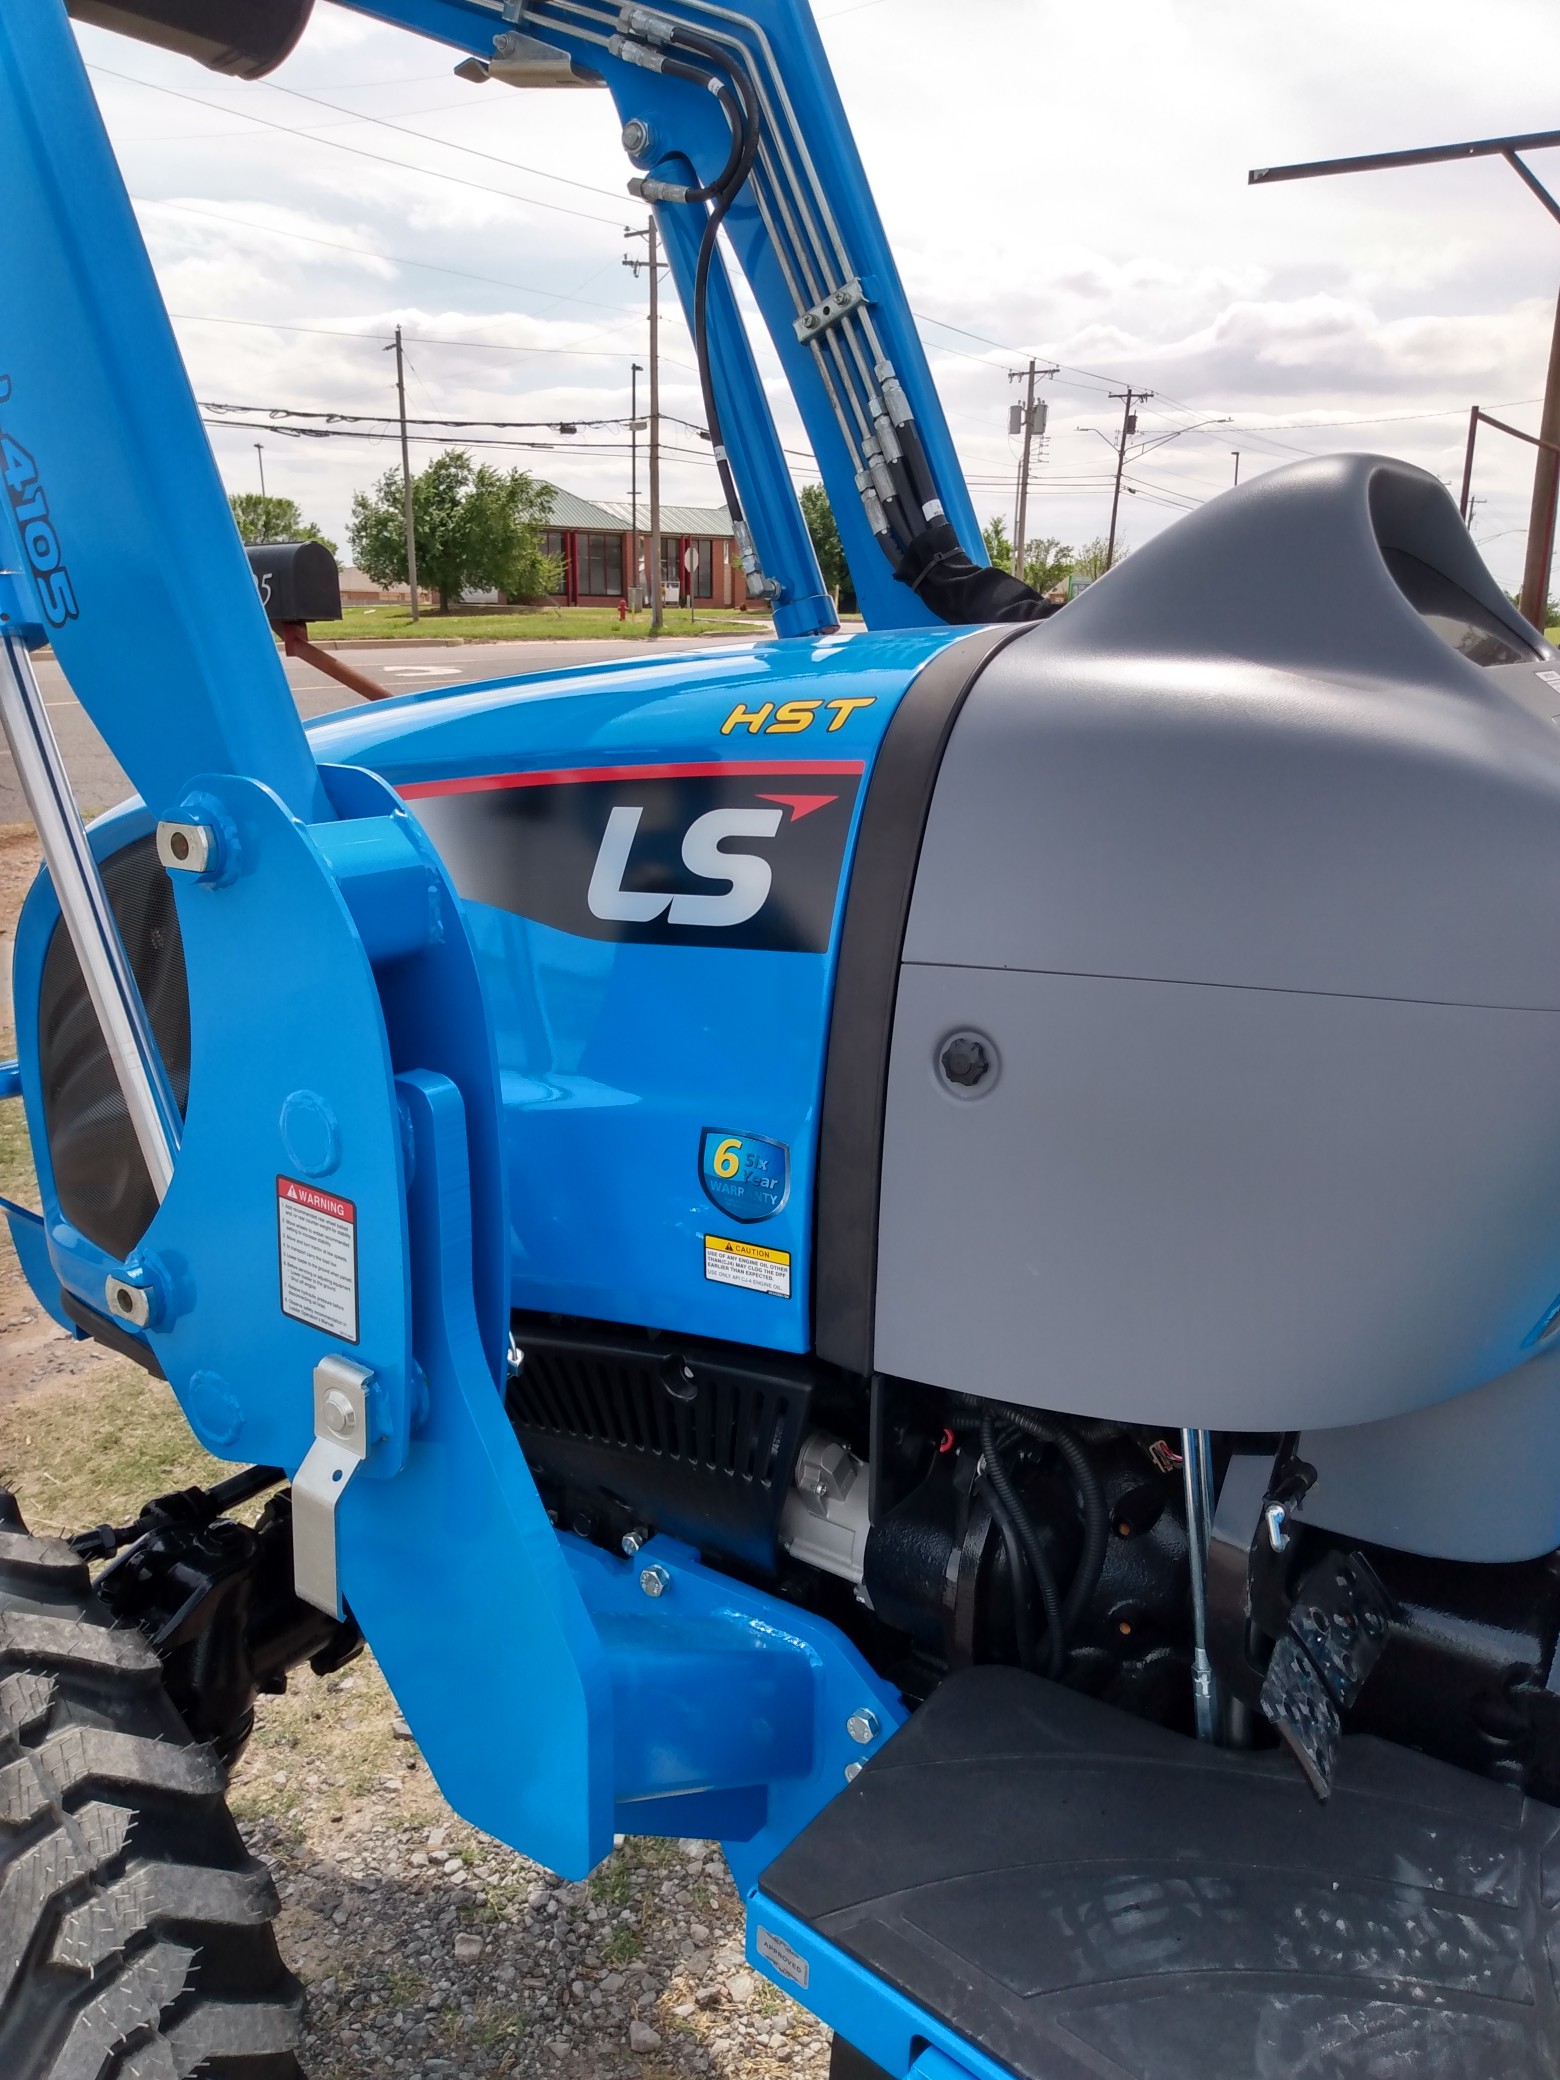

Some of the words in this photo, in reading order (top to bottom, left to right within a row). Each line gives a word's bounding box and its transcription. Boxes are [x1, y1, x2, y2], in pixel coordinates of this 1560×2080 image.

[253, 572, 273, 607] 5
[720, 697, 877, 735] HST
[588, 807, 783, 927] LS
[713, 1138, 742, 1179] 6
[744, 1153, 769, 1171] Six
[743, 1169, 778, 1189] Year
[299, 1190, 345, 1216] WARNING
[710, 1180, 778, 1205] WARRNTY
[736, 1245, 770, 1258] CAUTION
[708, 1261, 729, 1270] EARLIER
[739, 1257, 758, 1266] ENGINE
[770, 1264, 788, 1272] OTHER
[753, 1279, 771, 1287] ENGINE
[763, 1941, 802, 1974] APPROVED
